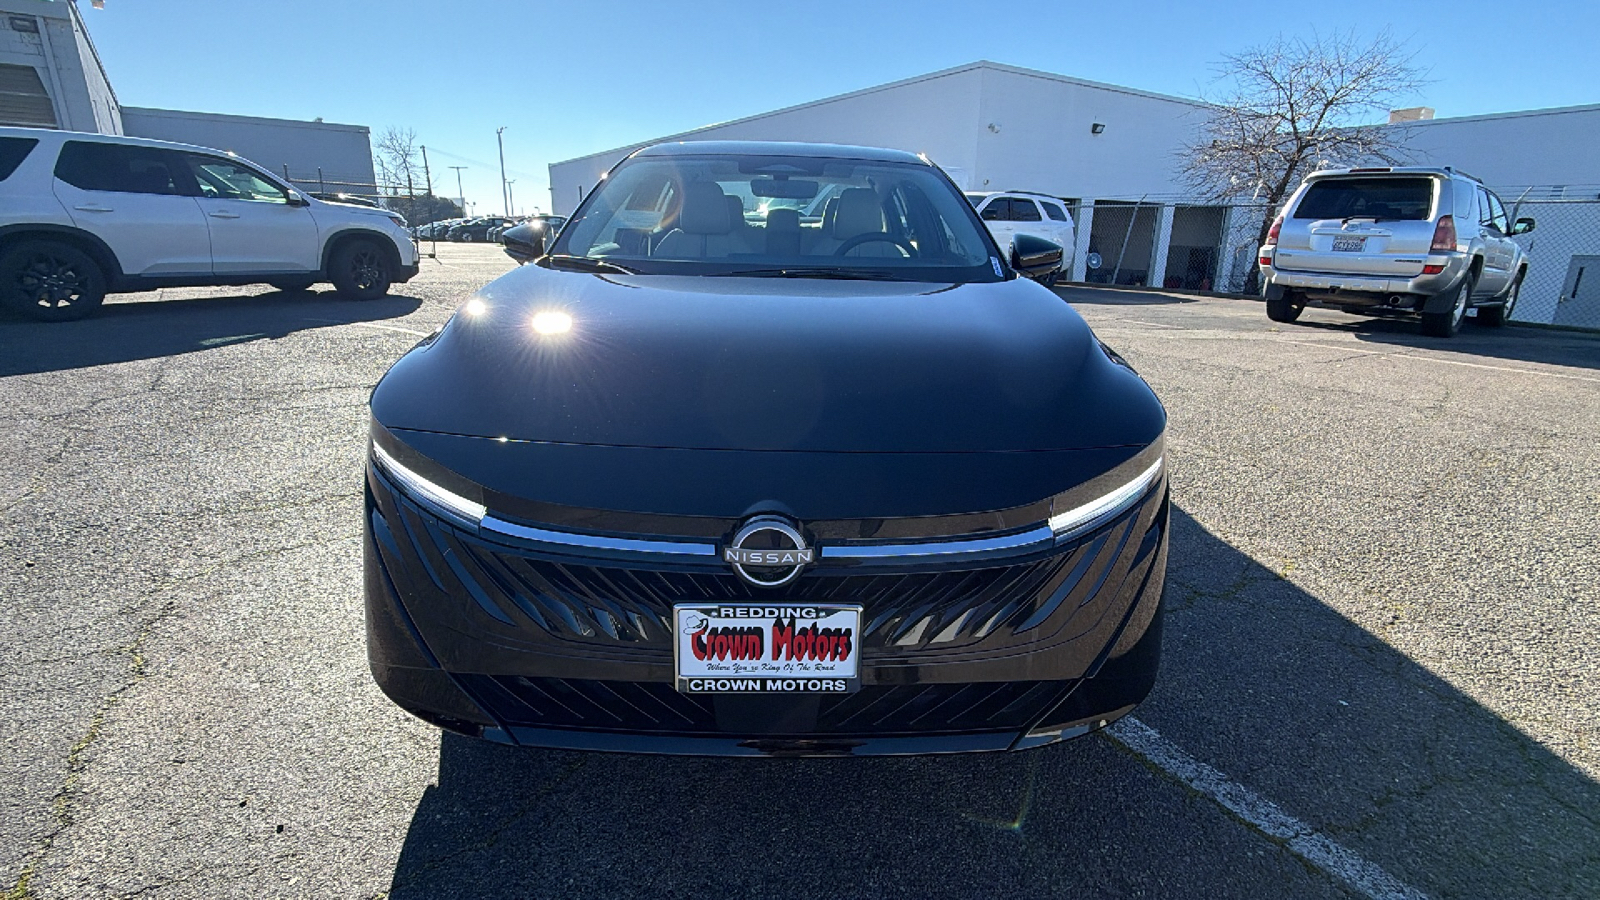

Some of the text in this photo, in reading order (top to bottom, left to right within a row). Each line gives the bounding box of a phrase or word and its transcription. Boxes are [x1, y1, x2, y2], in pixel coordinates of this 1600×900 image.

[725, 550, 811, 564] NISSAN
[720, 607, 817, 619] REDDING
[690, 618, 852, 662] Crown Motors
[706, 663, 731, 671] Where
[761, 663, 781, 673] King
[783, 663, 794, 673] Of
[796, 663, 811, 671] The
[814, 663, 836, 672] Road
[689, 679, 847, 691] CROWN MOTORS
